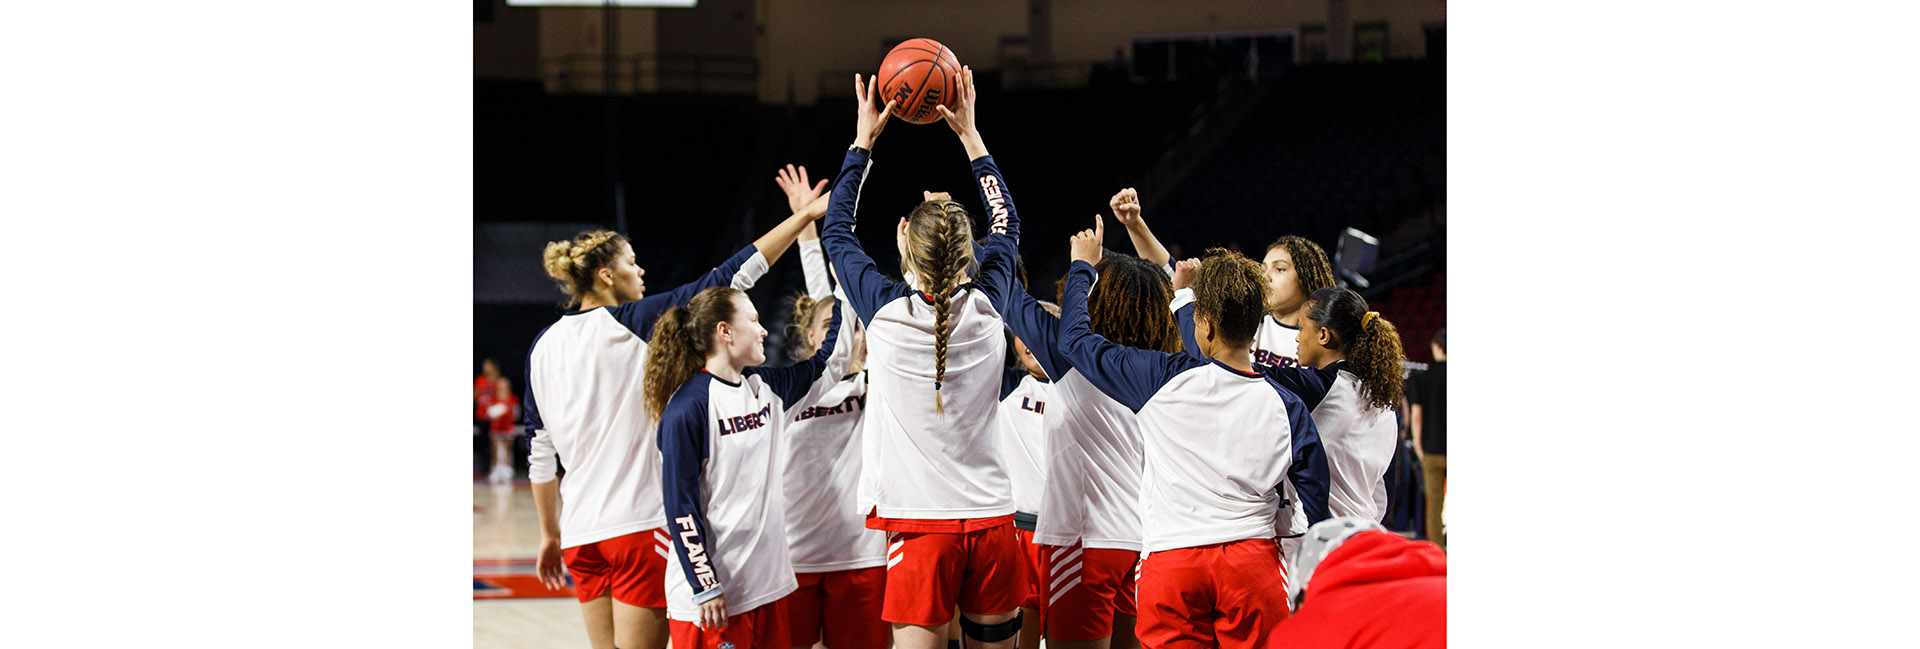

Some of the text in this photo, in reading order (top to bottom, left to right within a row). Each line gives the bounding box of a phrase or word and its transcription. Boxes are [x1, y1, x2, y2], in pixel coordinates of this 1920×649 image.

[893, 81, 914, 114] NC
[911, 88, 942, 122] Wils
[979, 174, 1009, 235] FLAMES
[1021, 396, 1045, 415] LI
